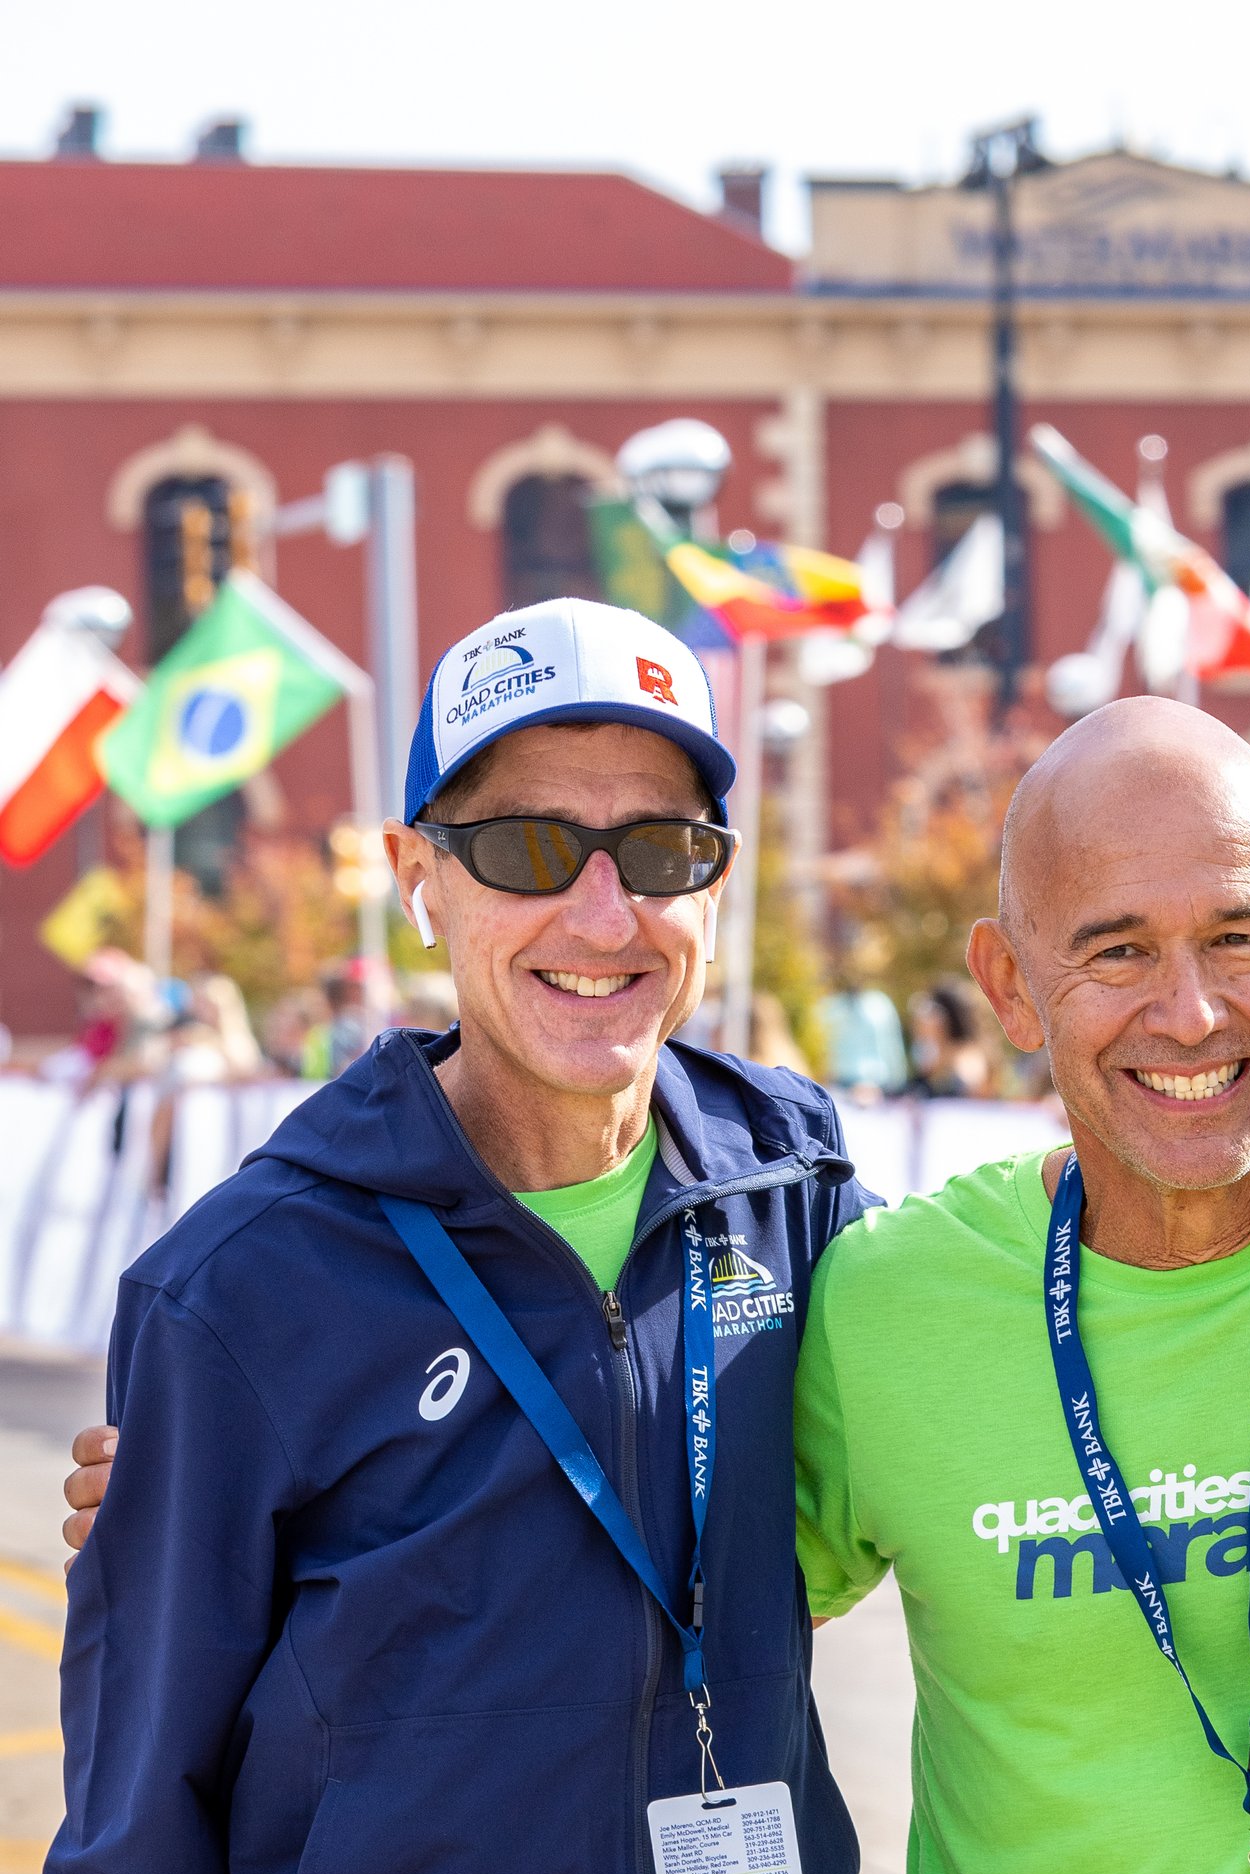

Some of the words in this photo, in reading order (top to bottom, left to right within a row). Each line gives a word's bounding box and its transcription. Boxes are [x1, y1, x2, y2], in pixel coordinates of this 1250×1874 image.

[463, 646, 482, 662] TBK
[494, 628, 527, 647] BANK
[446, 688, 490, 724] QUAD
[494, 666, 556, 694] CITIES
[461, 685, 536, 726] MARATHON
[728, 1234, 748, 1246] BANK
[1053, 1218, 1073, 1279] BANK
[689, 1248, 707, 1312] BANK
[712, 1301, 741, 1323] AD
[742, 1292, 795, 1318] CITIES
[713, 1317, 782, 1338] MARATHON
[1055, 1300, 1073, 1345] TBK
[691, 1365, 709, 1406] TBK
[1072, 1391, 1104, 1456] BANK
[693, 1434, 708, 1499] BANK
[1098, 1478, 1127, 1527] TBK
[1134, 1571, 1169, 1637] BANK
[660, 1831, 675, 1840] Emily
[707, 1822, 729, 1831] Medical
[661, 1838, 679, 1846] James
[699, 1839, 719, 1847] Course
[664, 1860, 680, 1868] Sarah
[665, 1867, 685, 1874] Monica
[722, 1858, 738, 1866] Zones
